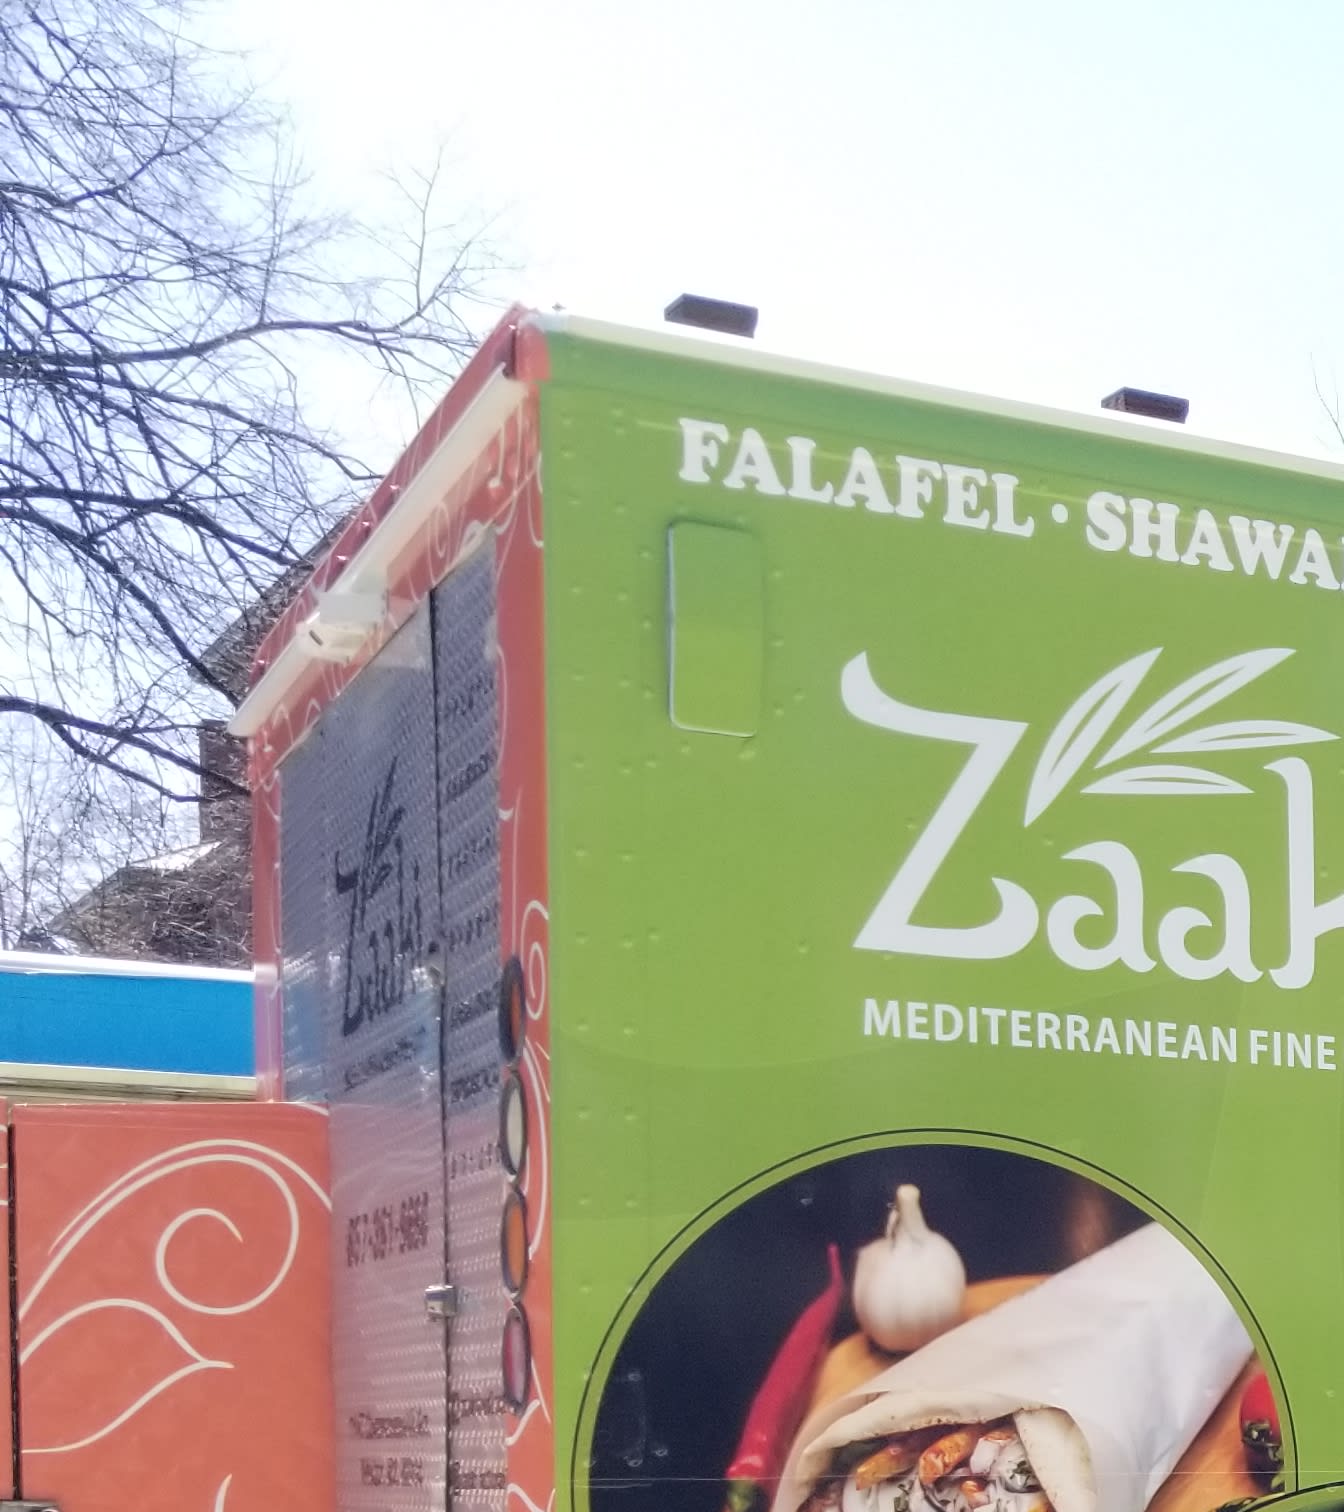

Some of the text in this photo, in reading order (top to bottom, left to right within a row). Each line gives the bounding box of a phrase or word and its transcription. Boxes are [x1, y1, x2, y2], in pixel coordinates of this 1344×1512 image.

[677, 417, 1034, 538] FALAFEL
[863, 998, 1239, 1064] MEDITERRANEAN
[1248, 1030, 1338, 1073] FINE
